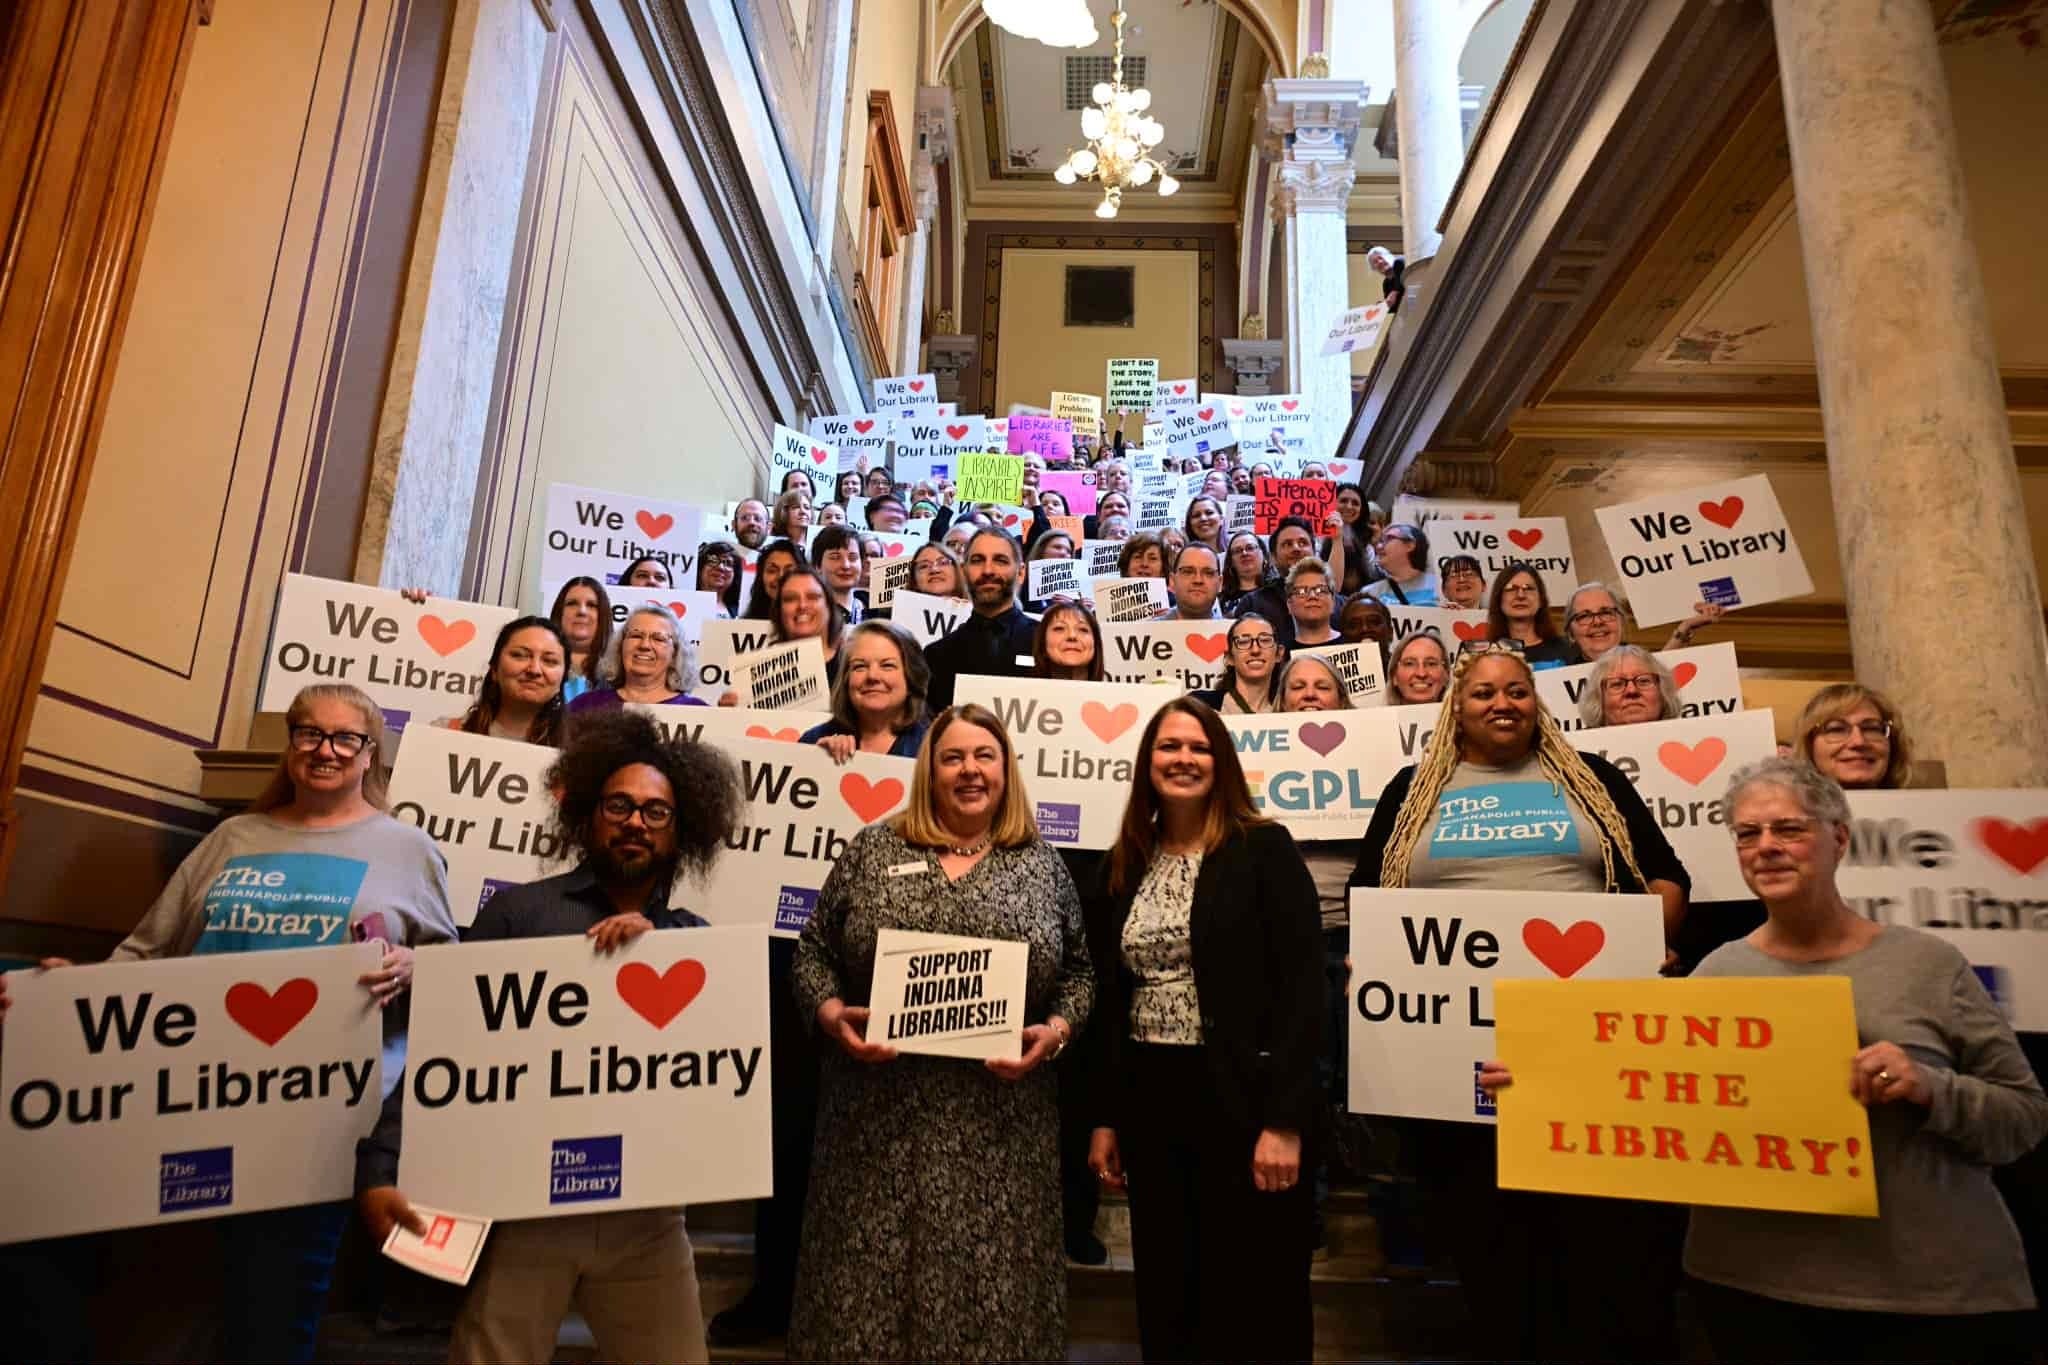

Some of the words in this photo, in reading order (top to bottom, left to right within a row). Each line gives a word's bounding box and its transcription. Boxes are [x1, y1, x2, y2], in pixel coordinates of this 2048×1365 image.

[884, 383, 905, 394] We
[877, 399, 896, 407] Our
[899, 394, 937, 405] Library
[1256, 400, 1277, 412] We
[1009, 419, 1071, 432] LIBRARIES
[1173, 416, 1195, 429] We
[1245, 413, 1265, 423] Our
[1270, 409, 1311, 423] Library
[824, 422, 848, 435] We
[912, 426, 940, 440] We
[1031, 432, 1051, 441] ARE
[1168, 429, 1190, 444] Our
[1190, 419, 1228, 438] Library
[786, 436, 807, 458] We
[897, 444, 926, 457] Our
[1243, 440, 1262, 449] Our
[774, 453, 795, 469] Our
[962, 456, 1021, 478] LIBRARIES
[963, 478, 1018, 502] INSPIRE!
[1264, 480, 1336, 504] Literacy
[576, 501, 624, 530] We
[1141, 509, 1168, 518] INDIANA
[1142, 501, 1170, 509] SUPPORT
[1630, 511, 1692, 543] We
[548, 530, 598, 555] Our
[1454, 530, 1499, 550] We
[1093, 554, 1120, 566] INDIAN
[1621, 552, 1674, 578] Our
[1682, 528, 1787, 566] Library
[1042, 562, 1074, 575] SUPPORT
[1042, 572, 1072, 585] INDIANA
[1110, 582, 1149, 600] SUPPORT
[1111, 593, 1149, 613] INDIANA
[326, 599, 399, 644] We
[924, 609, 958, 636] W
[731, 633, 768, 654] W
[1115, 635, 1173, 661] We
[278, 642, 355, 679] Our
[368, 654, 485, 696] Librar
[750, 648, 799, 681] SUPPORT
[752, 667, 799, 698] INDIANA
[993, 697, 1064, 736] We
[1230, 729, 1290, 752] WE
[1037, 748, 1132, 782] Libra
[448, 752, 529, 804] We
[742, 760, 820, 810] We
[1440, 795, 1499, 818] The
[390, 801, 476, 845] Our
[1434, 820, 1571, 842] Library
[728, 824, 770, 853] ur
[215, 866, 286, 887] The
[208, 888, 303, 903] INDIANAPOLIS
[305, 892, 352, 905] PUBLIC
[780, 892, 804, 906] The
[205, 902, 343, 942] Library
[1401, 916, 1499, 969] We
[907, 948, 992, 979] SUPPORT
[475, 970, 589, 1032] We
[904, 975, 983, 1008] INDIANA
[1357, 980, 1450, 1024] Our
[75, 992, 197, 1055] We
[887, 999, 1008, 1040] LIBRARIES!!!
[1593, 1011, 1773, 1050] FUND
[414, 1057, 528, 1109] Our
[550, 1045, 762, 1098] Library
[1619, 1068, 1750, 1108] THE
[10, 1079, 134, 1130] Our
[157, 1058, 375, 1115] Library
[552, 1149, 587, 1166] The
[1548, 1121, 1861, 1179] LIBRARY!
[161, 1163, 196, 1178] The
[162, 1184, 230, 1203] Library
[552, 1176, 619, 1194] Library
